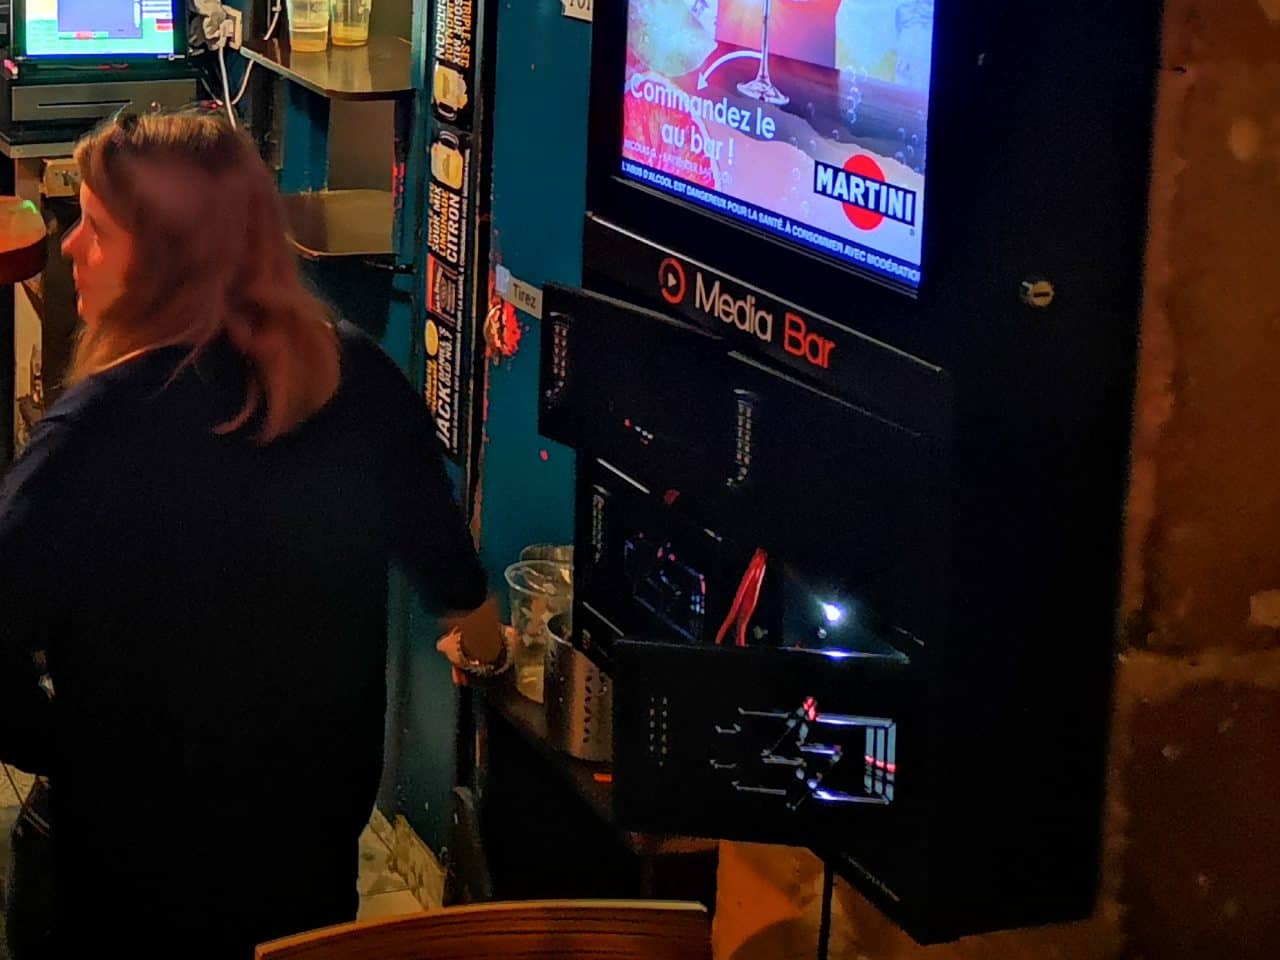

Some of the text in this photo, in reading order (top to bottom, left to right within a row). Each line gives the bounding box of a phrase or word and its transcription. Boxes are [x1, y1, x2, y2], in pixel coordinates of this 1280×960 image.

[452, 39, 462, 64] MIX
[629, 74, 777, 139] Commandez le
[662, 124, 684, 149] au
[689, 128, 724, 159] bar
[816, 164, 914, 223] MARTINI
[447, 193, 461, 263] CITRON
[727, 201, 748, 217] POUR
[748, 208, 758, 221] LA
[843, 245, 866, 261] AVEC
[511, 282, 537, 309] Tirez
[694, 272, 837, 369] Media Bar
[435, 383, 451, 448] JACK
